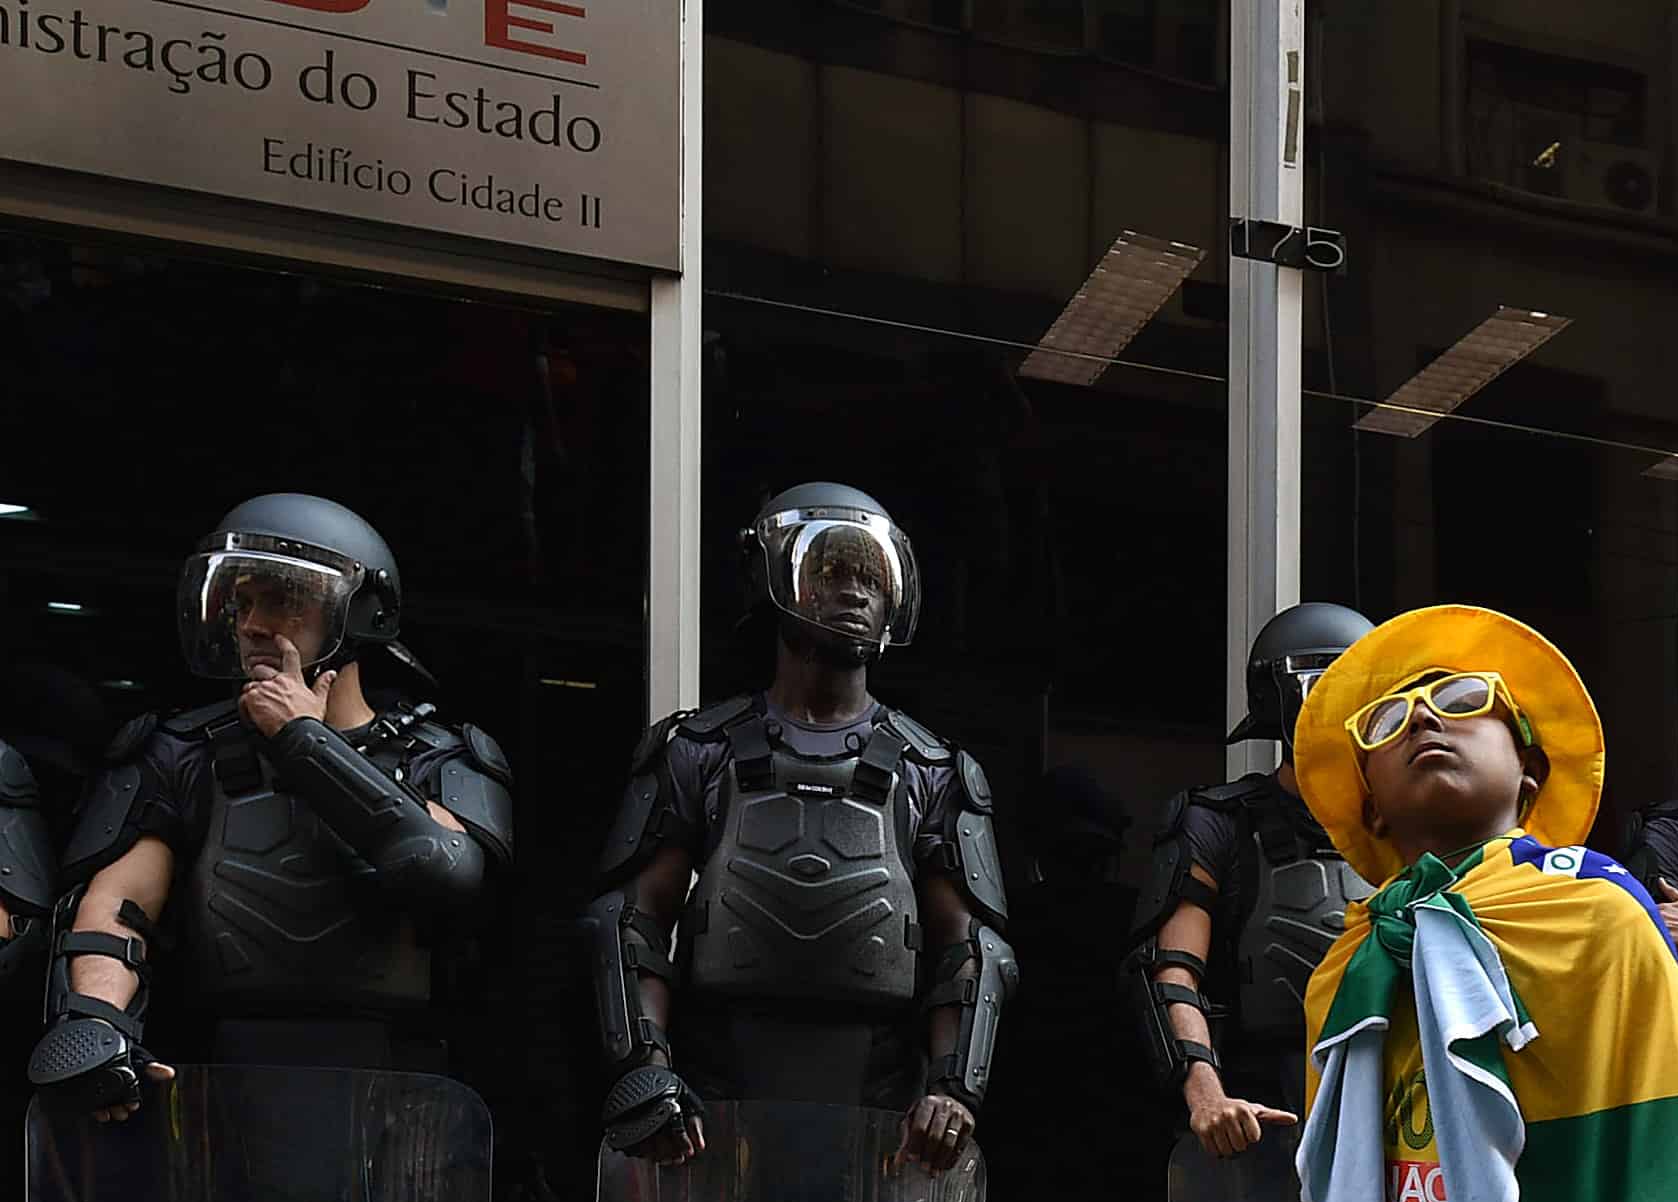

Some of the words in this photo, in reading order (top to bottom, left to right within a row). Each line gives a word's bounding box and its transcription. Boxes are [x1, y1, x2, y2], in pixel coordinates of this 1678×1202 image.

[300, 50, 377, 111] do
[407, 69, 601, 153] Estado
[263, 137, 411, 195] Edifício
[428, 167, 563, 222] Cidade
[581, 195, 601, 229] II
